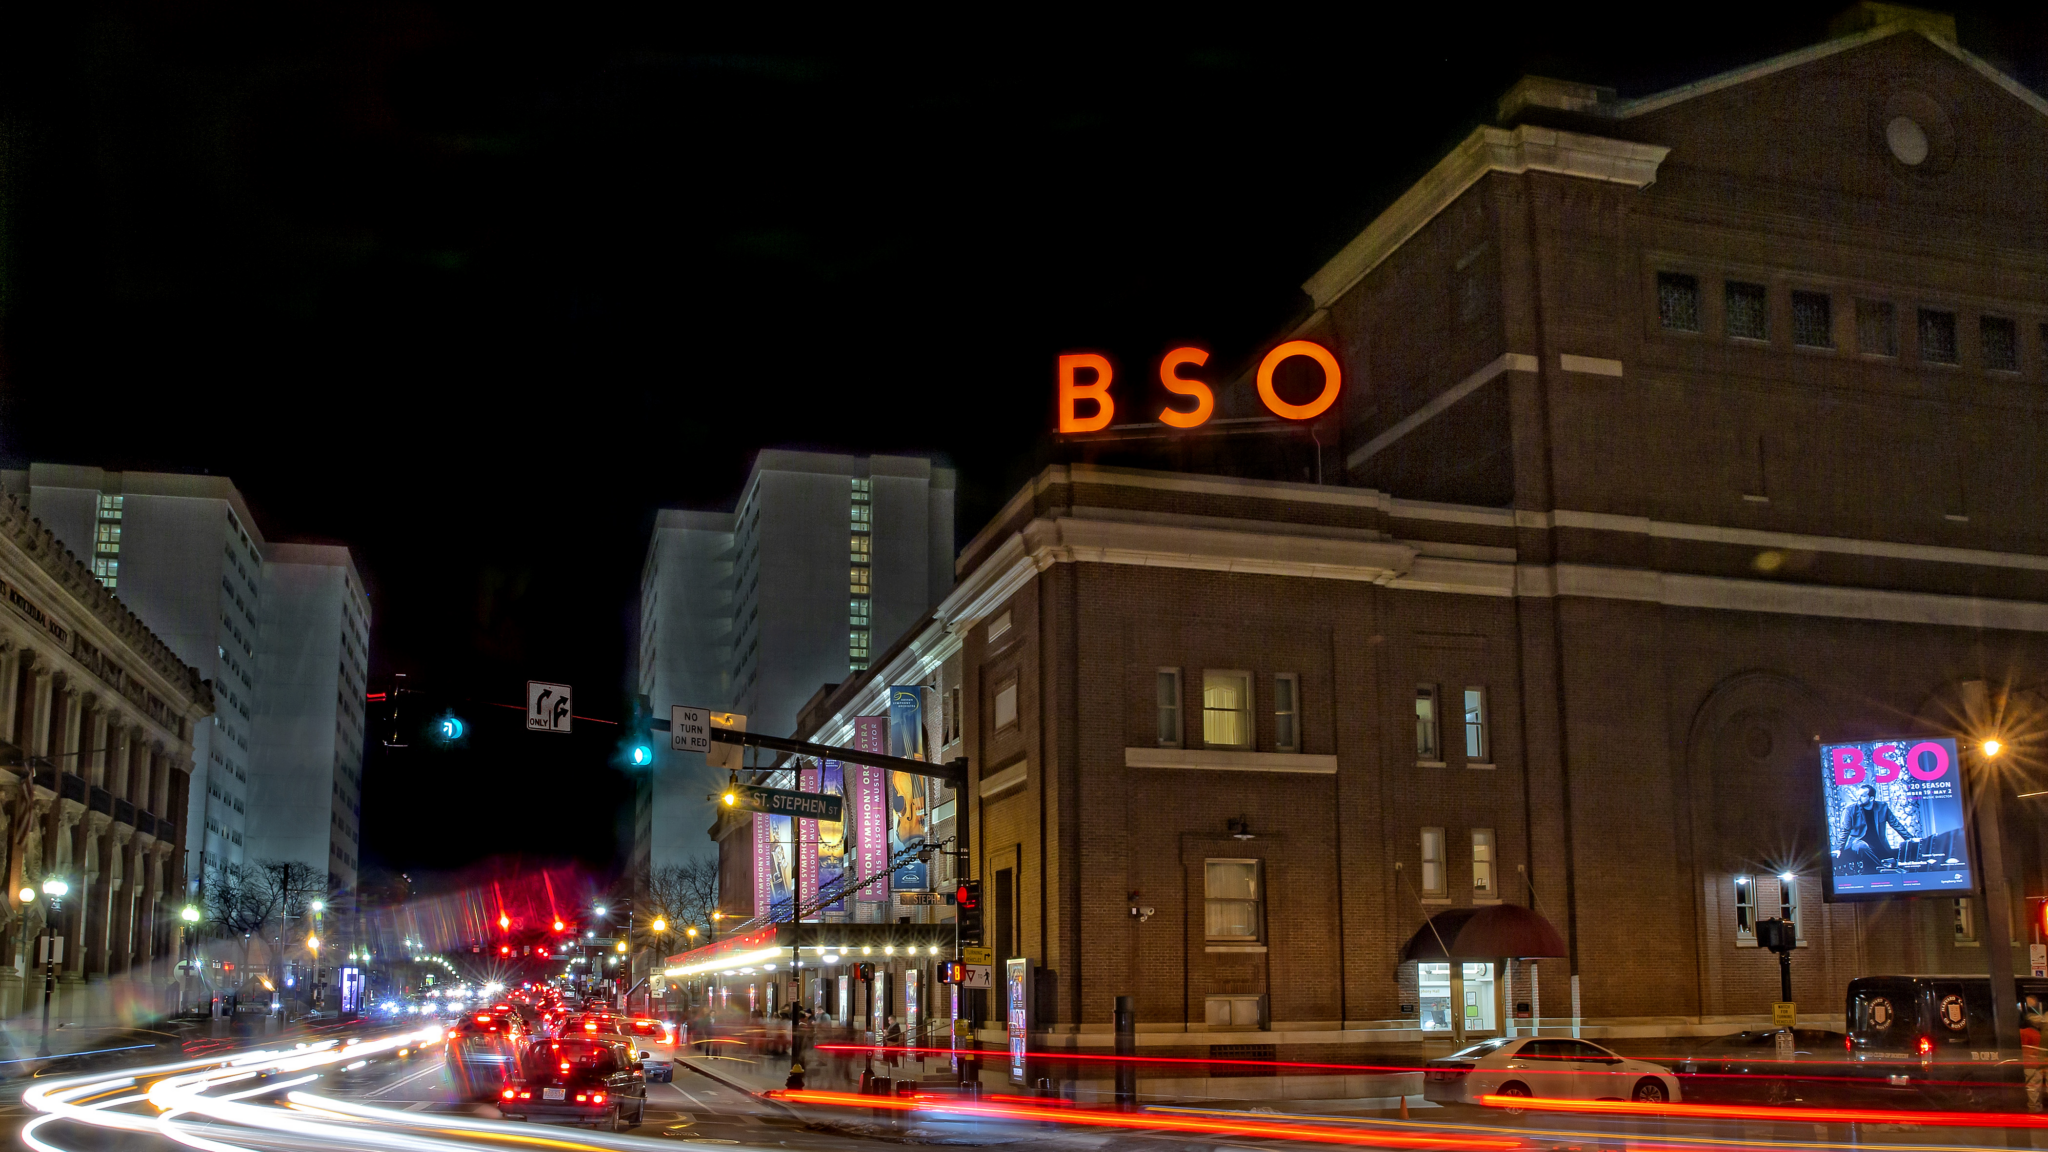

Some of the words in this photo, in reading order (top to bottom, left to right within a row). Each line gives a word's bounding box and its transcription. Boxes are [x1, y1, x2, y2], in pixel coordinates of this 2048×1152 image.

[529, 717, 548, 727] ONLY
[684, 712, 698, 721] NO
[680, 723, 703, 734] TURN
[675, 735, 687, 745] ON
[690, 737, 707, 747] RED
[861, 723, 870, 785] ORCSTRA
[1832, 742, 1949, 786] BSO
[753, 793, 770, 807] ST.
[772, 794, 826, 814] STEPHEN
[829, 806, 838, 815] ST
[863, 788, 872, 849] SYMPHONY
[874, 813, 882, 856] NELSONS
[913, 894, 946, 904] STEPHEN
[655, 978, 660, 987] 9
